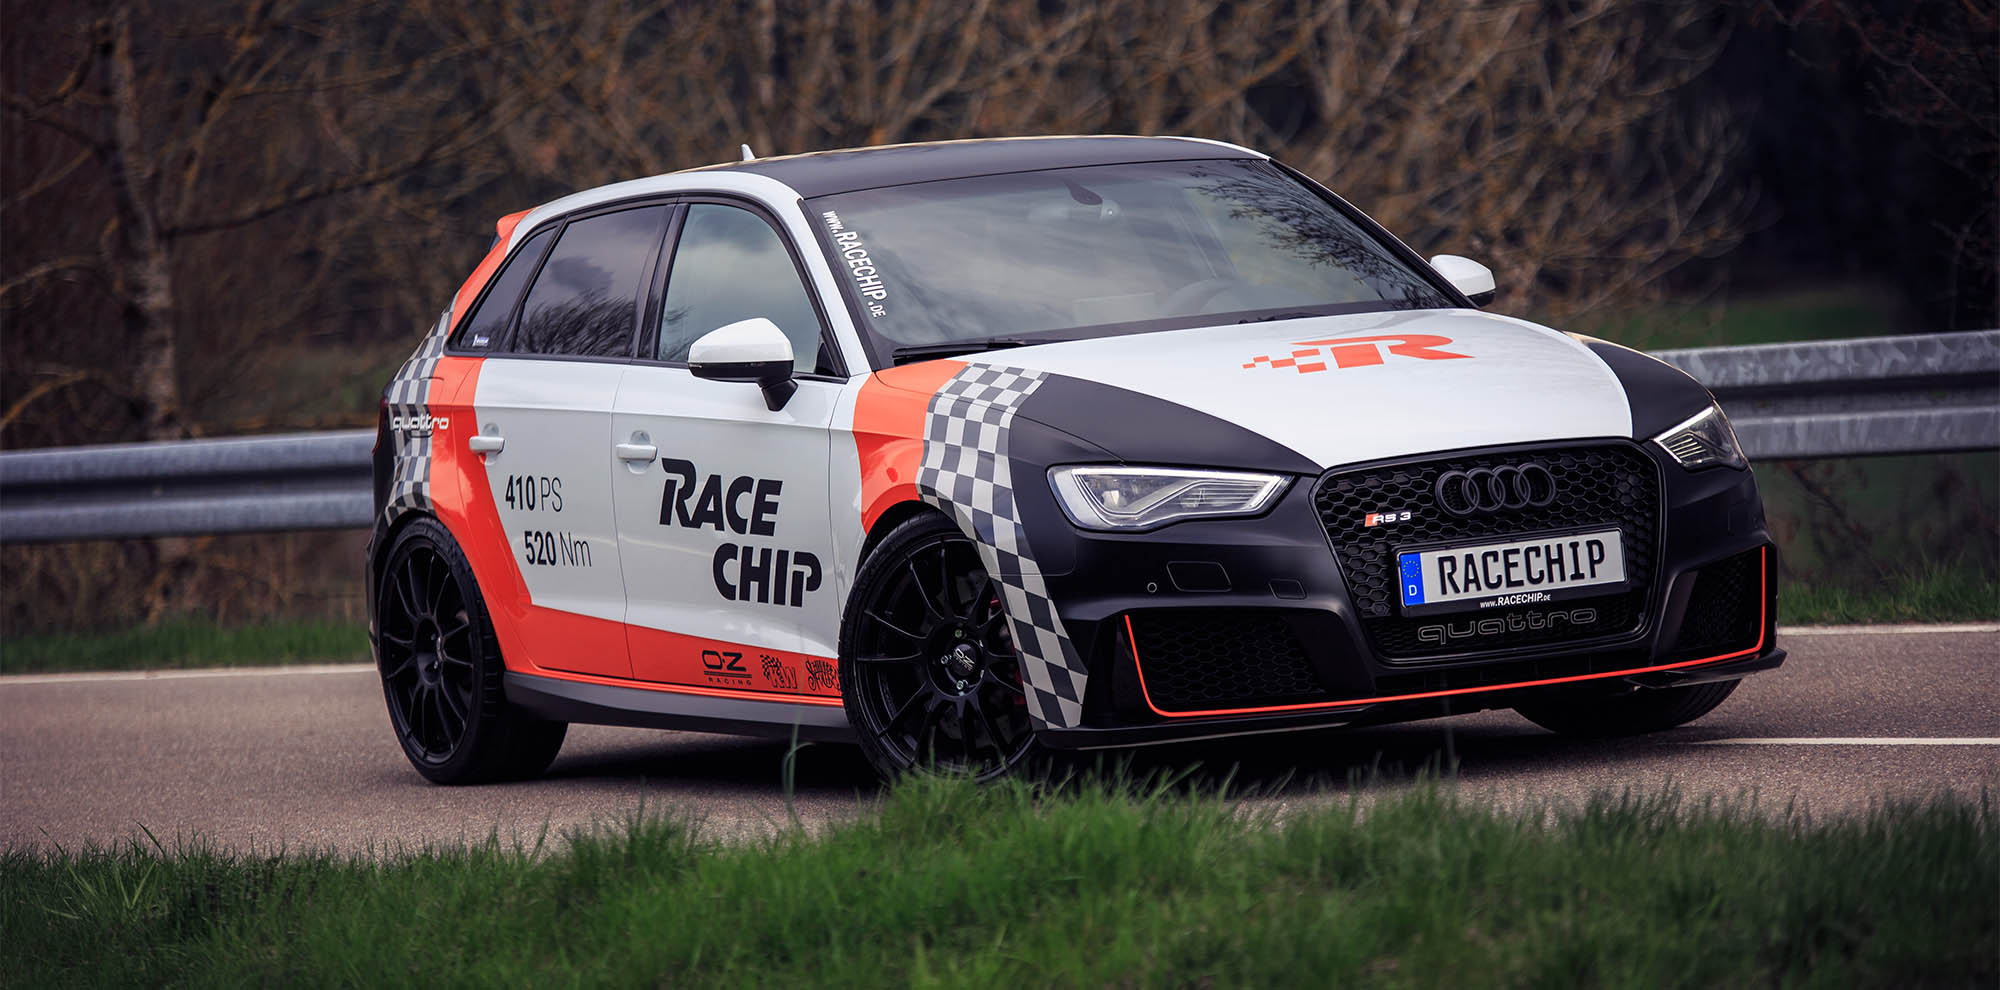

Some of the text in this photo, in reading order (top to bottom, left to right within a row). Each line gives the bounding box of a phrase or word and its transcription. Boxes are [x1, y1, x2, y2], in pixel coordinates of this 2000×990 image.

[392, 413, 449, 433] quattro
[505, 475, 563, 512] 410 PS
[659, 457, 783, 537] RACE
[1400, 511, 1411, 521] 3
[524, 530, 592, 568] 520 Nm
[1437, 538, 1605, 596] RACECHIP
[712, 542, 823, 608] CHIP
[1408, 584, 1417, 597] D
[1417, 608, 1597, 645] quattro
[707, 676, 752, 686] RACING
